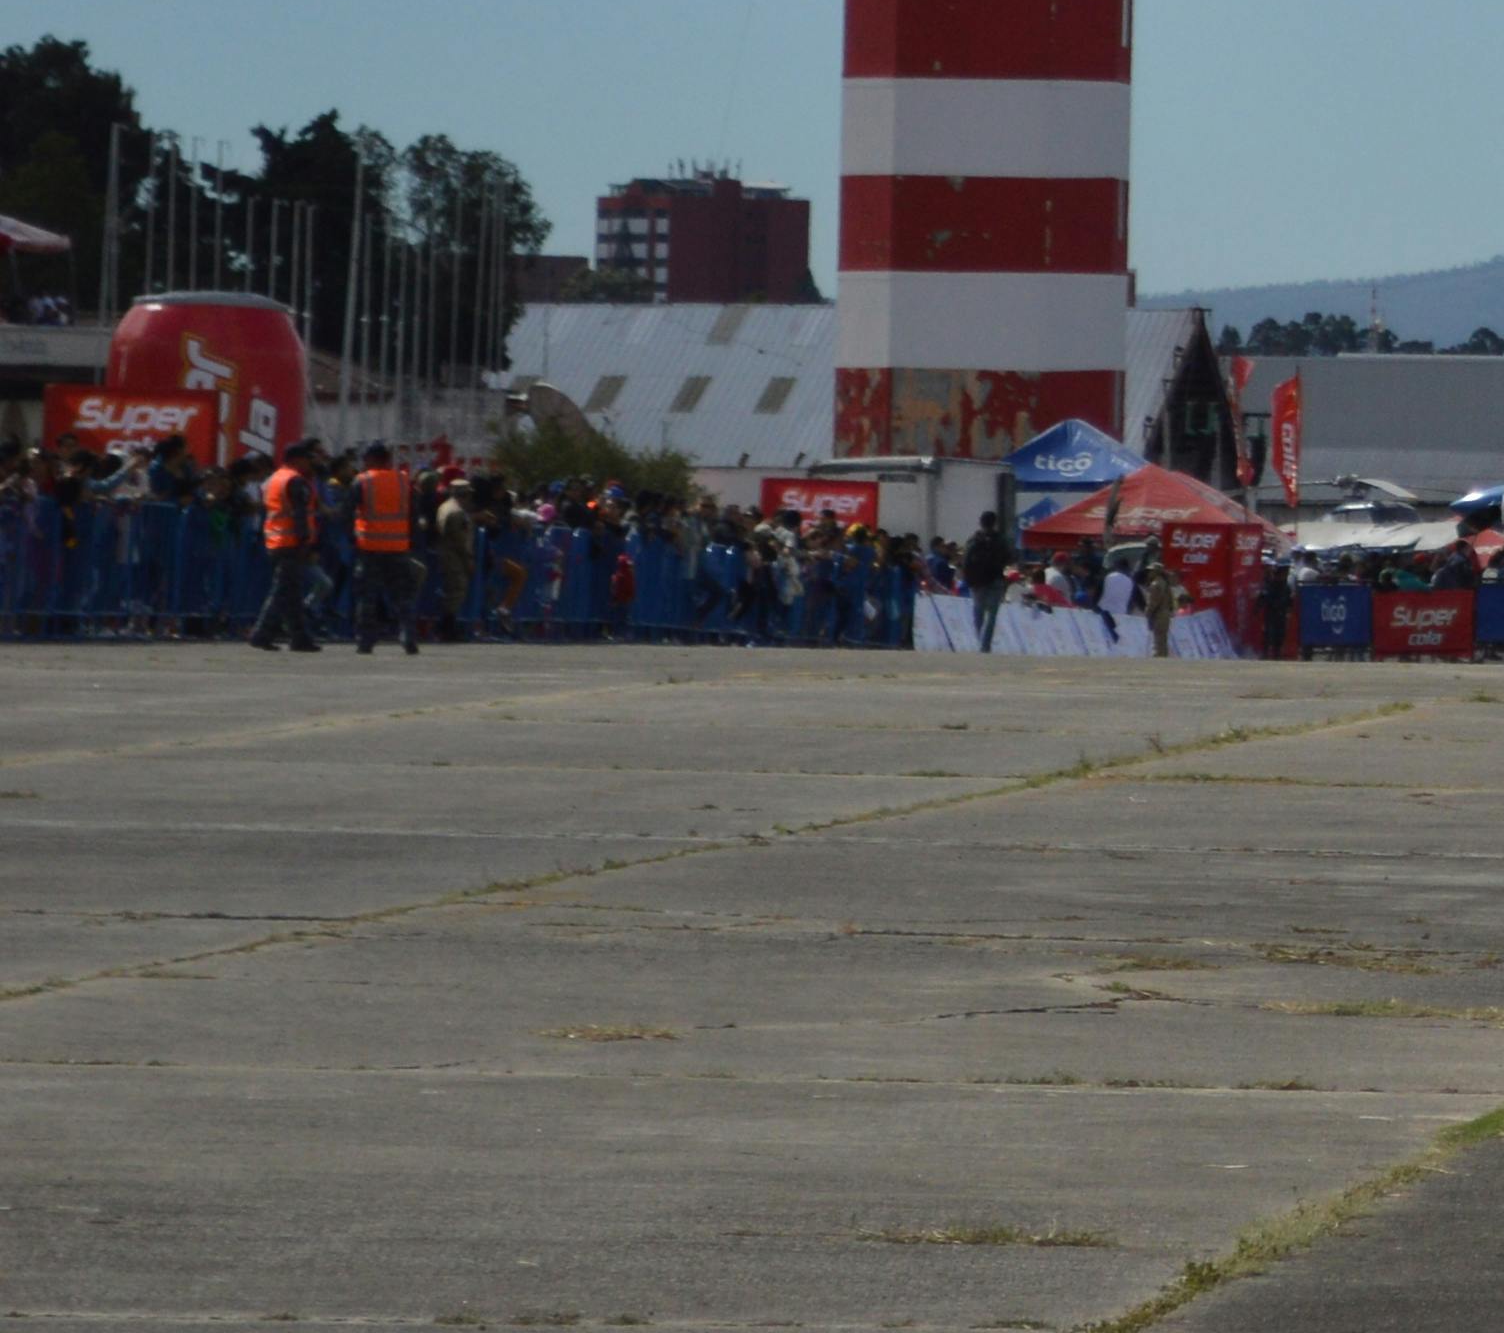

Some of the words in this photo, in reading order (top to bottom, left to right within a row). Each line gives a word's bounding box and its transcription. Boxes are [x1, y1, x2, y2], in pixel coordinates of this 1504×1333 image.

[73, 396, 198, 435] Super
[779, 486, 867, 520] Super
[1170, 530, 1221, 550] Super
[1391, 605, 1458, 630] Super
[1408, 631, 1445, 646] cola
